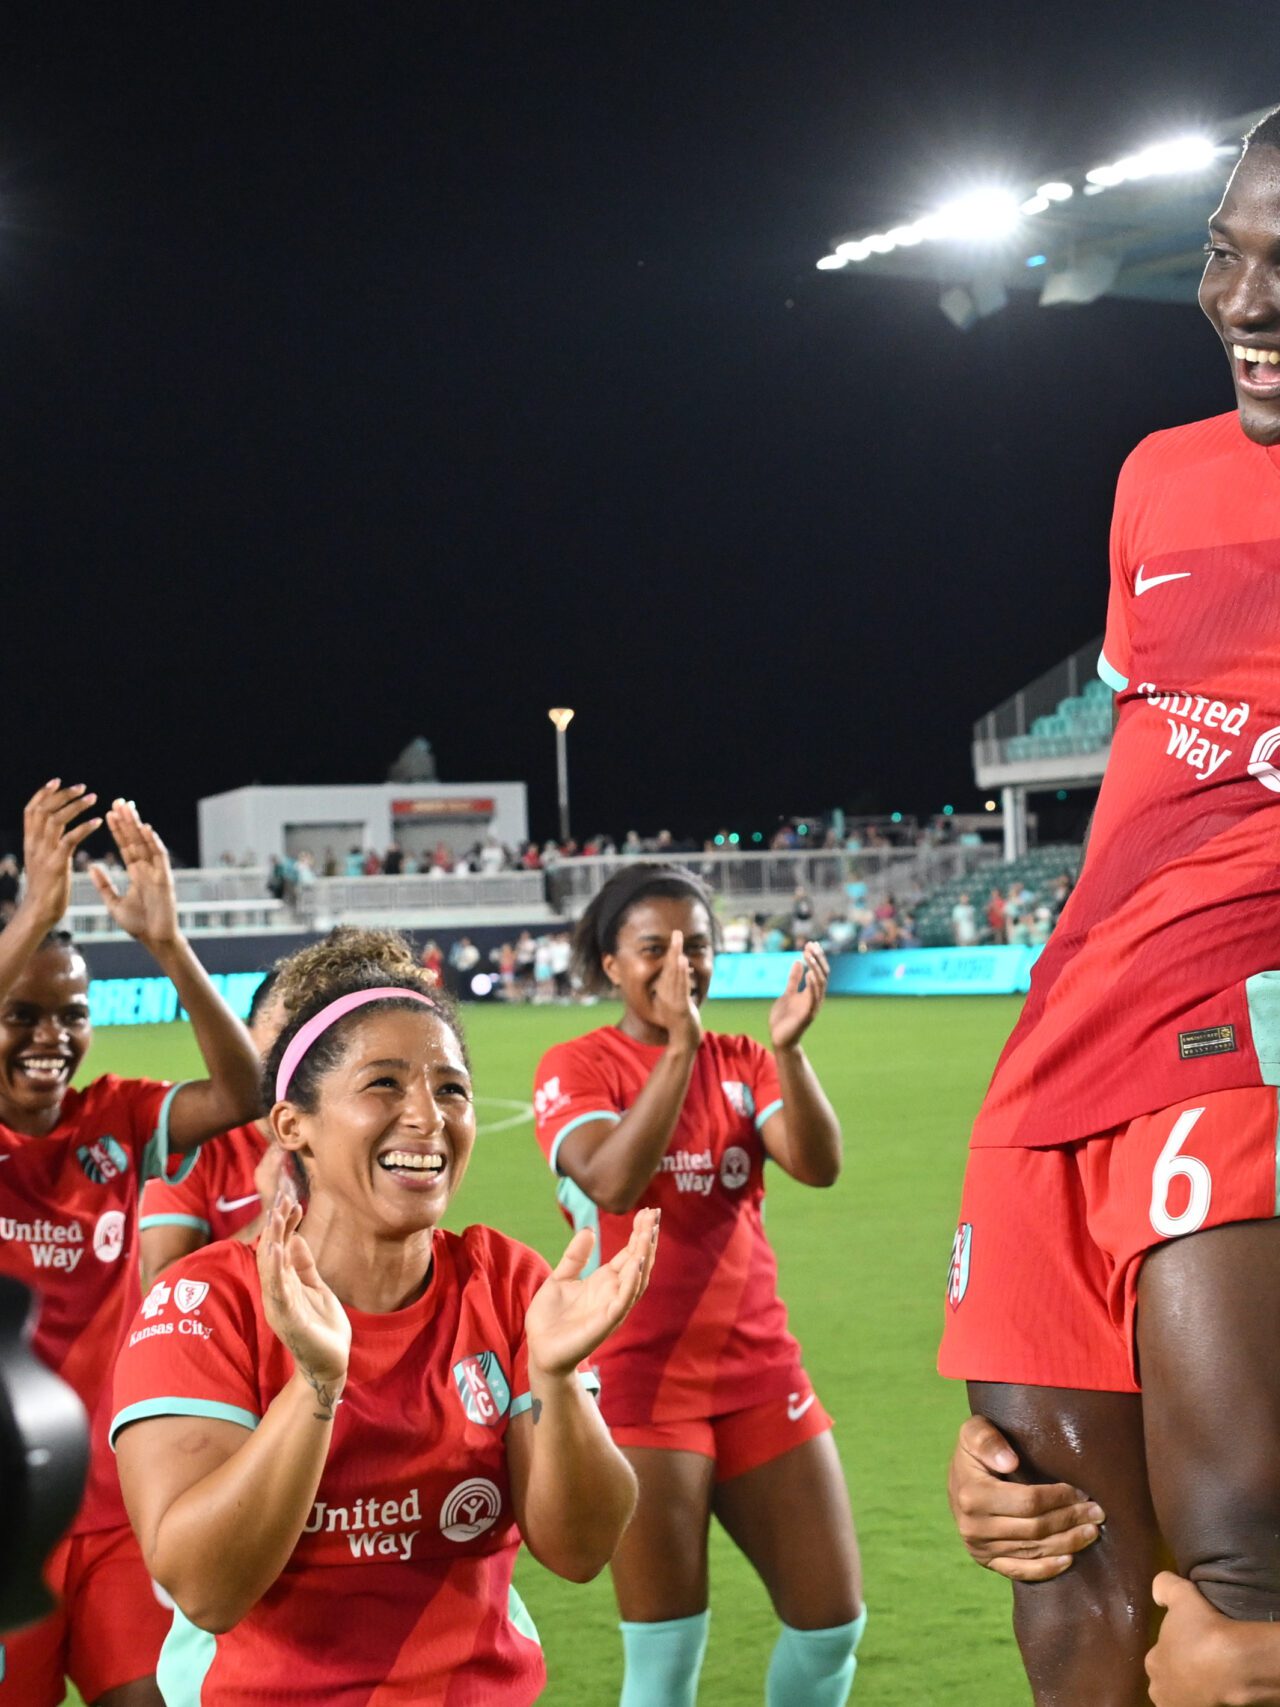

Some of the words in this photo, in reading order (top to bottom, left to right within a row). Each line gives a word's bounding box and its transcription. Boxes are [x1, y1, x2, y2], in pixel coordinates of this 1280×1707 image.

[1165, 718, 1232, 780] Way
[673, 1172, 715, 1196] Way
[1150, 1107, 1212, 1238] 6
[0, 1217, 84, 1243] United
[30, 1244, 84, 1273] Way
[128, 1322, 173, 1348] Kansas
[178, 1319, 213, 1339] City
[303, 1488, 422, 1533] United
[347, 1530, 420, 1561] Way
